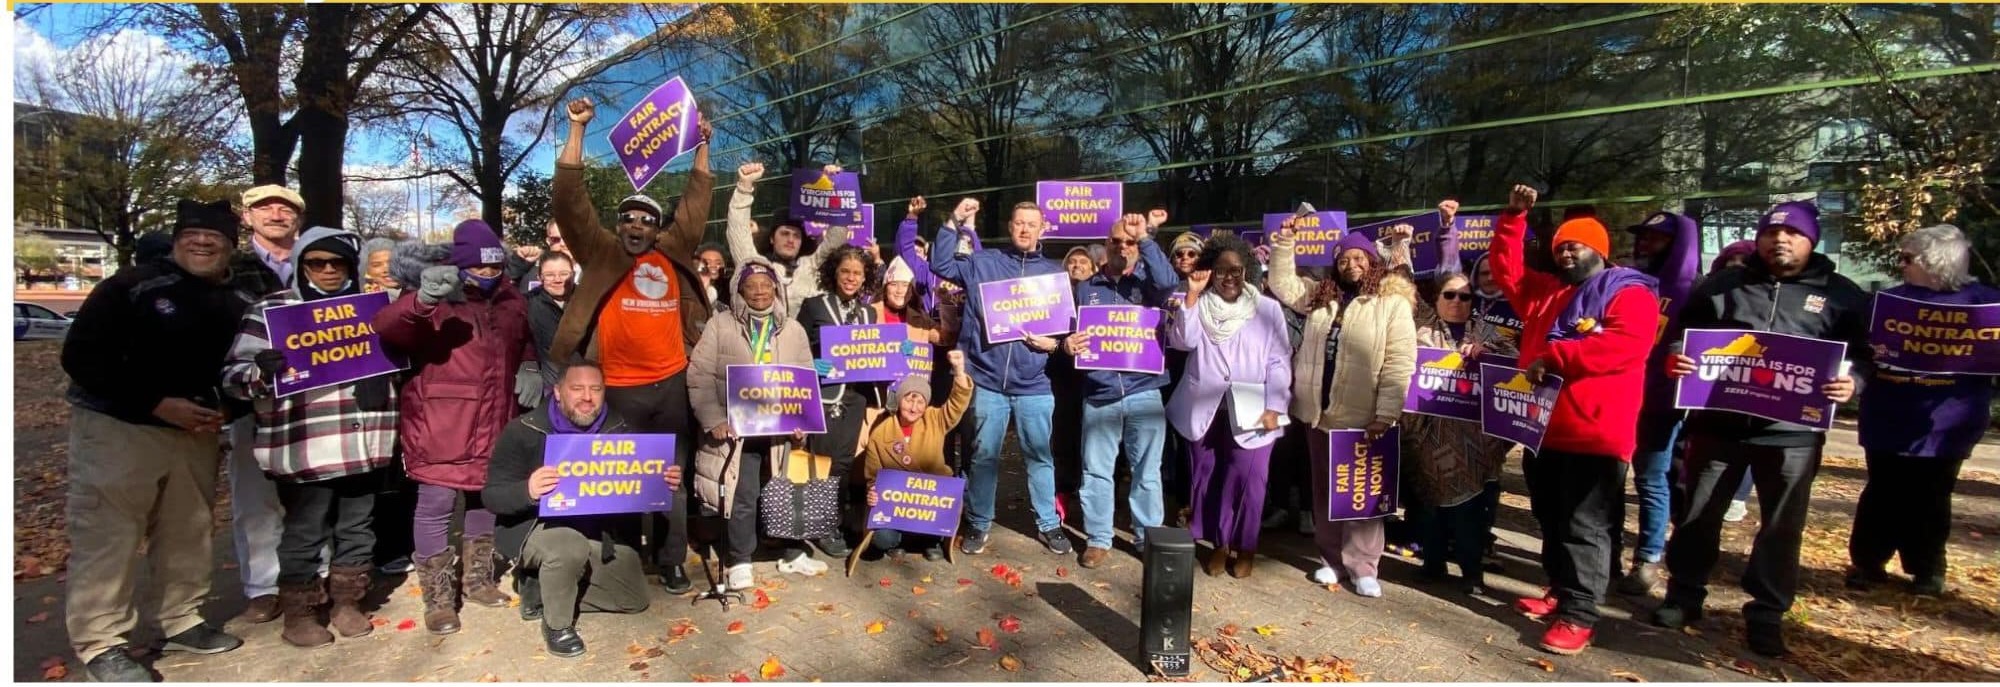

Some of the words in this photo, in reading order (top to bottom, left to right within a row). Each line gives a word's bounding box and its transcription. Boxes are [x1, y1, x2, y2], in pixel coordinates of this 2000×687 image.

[630, 102, 657, 129] FAIR
[624, 101, 684, 155] CONTRACT
[641, 123, 679, 159] NOW!
[800, 187, 836, 197] VIRGINIA
[1065, 186, 1092, 197] FAIR
[1045, 199, 1112, 210] CONTRACT
[1059, 213, 1098, 224] NOW!
[1298, 217, 1320, 228] AIR
[1465, 219, 1492, 229] FAIR
[1270, 230, 1341, 241] CNTRACT
[1296, 244, 1325, 255] OW!
[993, 293, 1061, 312] CONTRACT
[312, 304, 358, 324] FAIR
[1009, 310, 1050, 325] NOW!
[1108, 311, 1139, 323] FAIR
[1918, 308, 1969, 324] FAIR
[286, 322, 376, 350] CONTRA
[851, 328, 880, 341] FAIR
[1884, 318, 2000, 341] CONTRACT
[311, 341, 371, 366] NOW!
[830, 342, 902, 357] CONTRACT
[1100, 341, 1143, 354] NOW!
[1903, 339, 1974, 356] NOW!
[845, 357, 887, 370] NOW!
[1700, 355, 1767, 369] VIRGINIA
[1769, 360, 1783, 370] IS
[1786, 363, 1816, 378] FOR
[763, 370, 794, 383] FAIR
[1420, 366, 1467, 379] VIRGINIA
[1469, 372, 1480, 381] IS
[739, 387, 812, 400] CONTRACT
[1493, 387, 1537, 404] VIRGINIA
[757, 403, 802, 415] NOW!
[591, 440, 636, 456] FAIR
[557, 459, 665, 477] CONTRACT
[1370, 455, 1383, 496] NOW!
[906, 477, 937, 491] FAIR
[1336, 463, 1350, 493] FAIR
[1352, 442, 1367, 511] CONTRACT
[578, 480, 641, 497] NOW!
[882, 490, 955, 509] CONTRACT
[893, 506, 936, 522] NOW!
